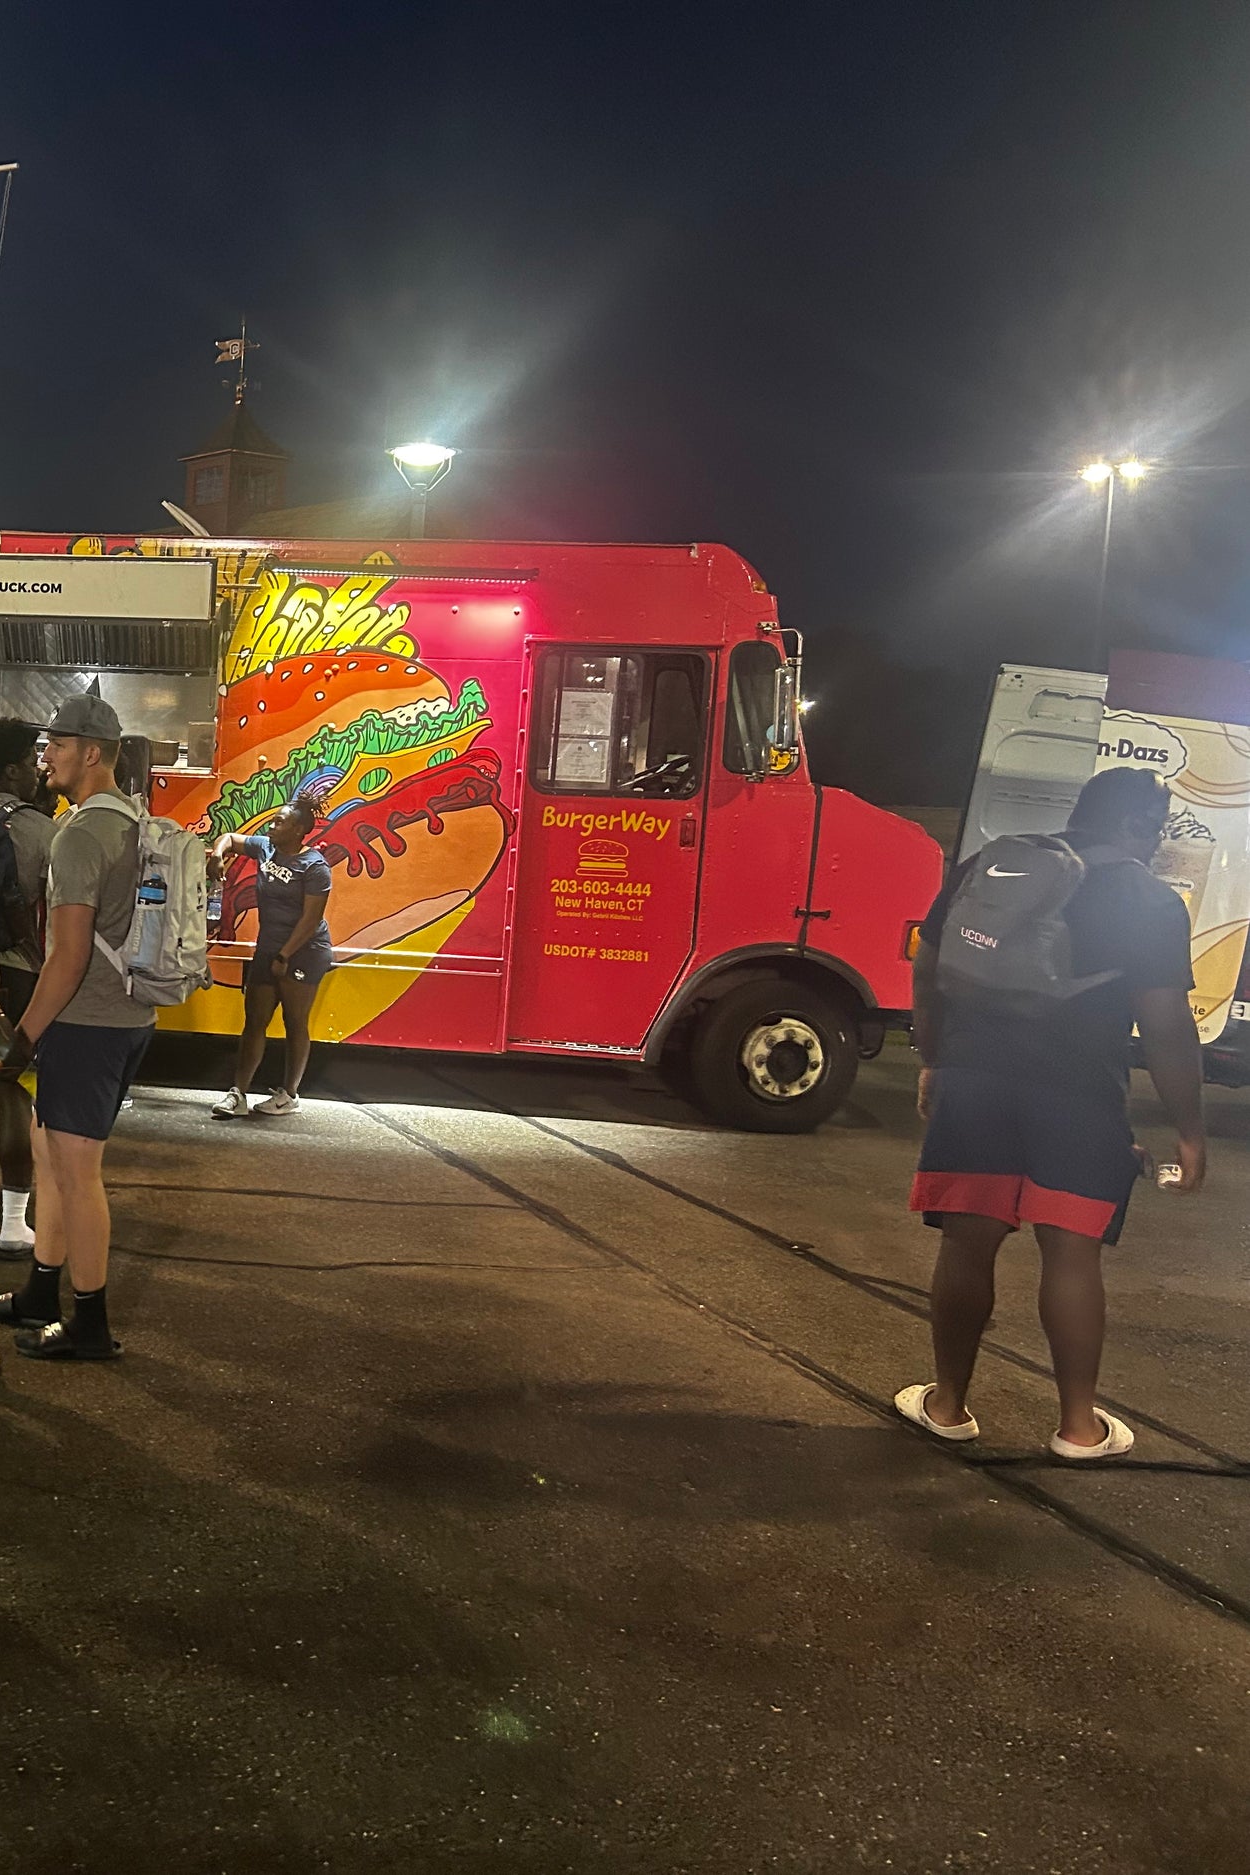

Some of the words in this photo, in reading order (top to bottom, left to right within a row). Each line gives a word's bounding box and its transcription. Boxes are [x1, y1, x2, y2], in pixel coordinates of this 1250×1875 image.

[542, 805, 671, 841] BurgerWay
[550, 879, 652, 897] 203-603-4444
[555, 896, 582, 908] New
[960, 926, 998, 948] UCONN
[544, 944, 597, 959] USDOT#
[599, 948, 649, 963] 3832881
